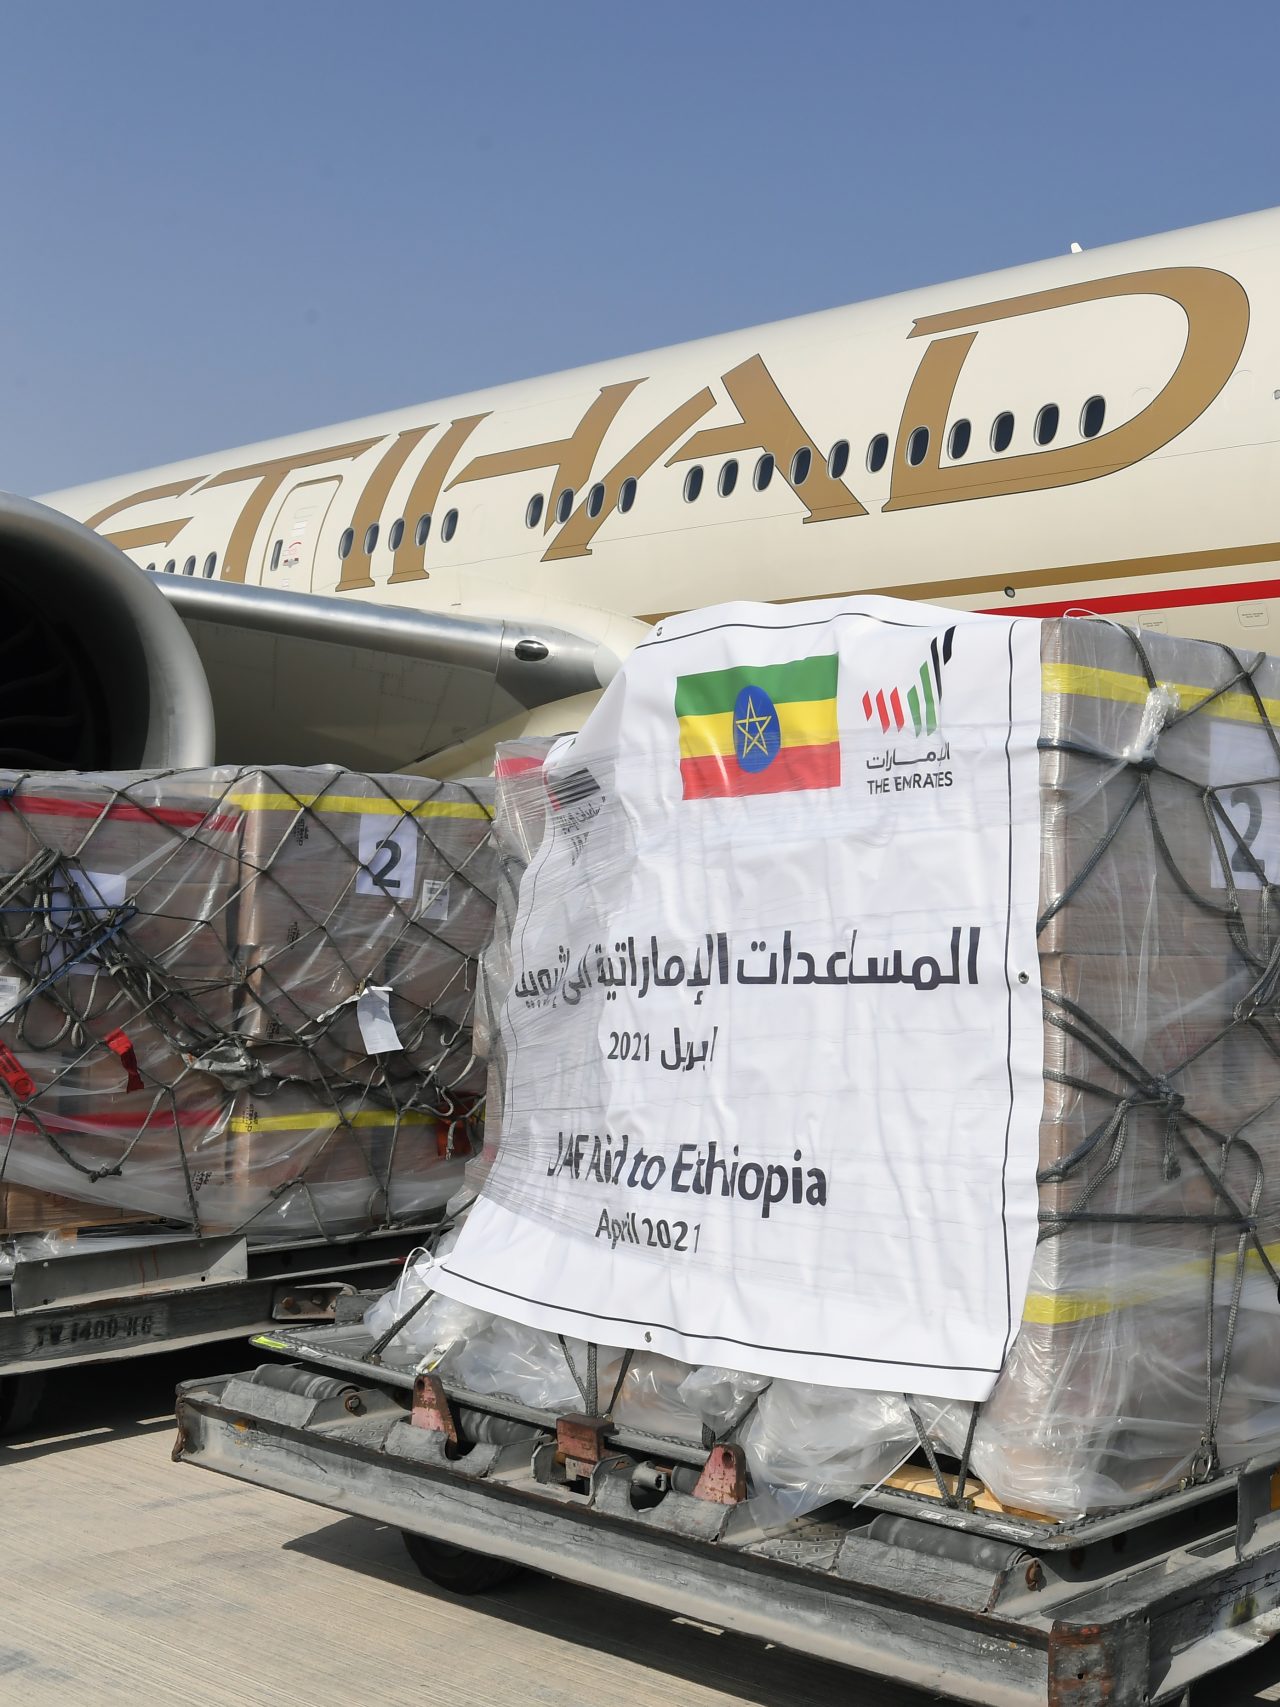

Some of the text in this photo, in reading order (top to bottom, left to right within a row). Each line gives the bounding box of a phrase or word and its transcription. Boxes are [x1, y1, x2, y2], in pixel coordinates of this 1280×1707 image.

[866, 777, 890, 795] THE
[1230, 787, 1265, 873] 2
[372, 839, 402, 889] 2
[594, 931, 729, 1005] الإماراتية
[736, 926, 981, 991] المساعدات
[607, 1031, 650, 1061] 2021
[585, 1133, 629, 1186] Aid
[626, 1147, 667, 1191] to
[670, 1141, 827, 1219] Ethiopia
[594, 1208, 702, 1254] April 2021
